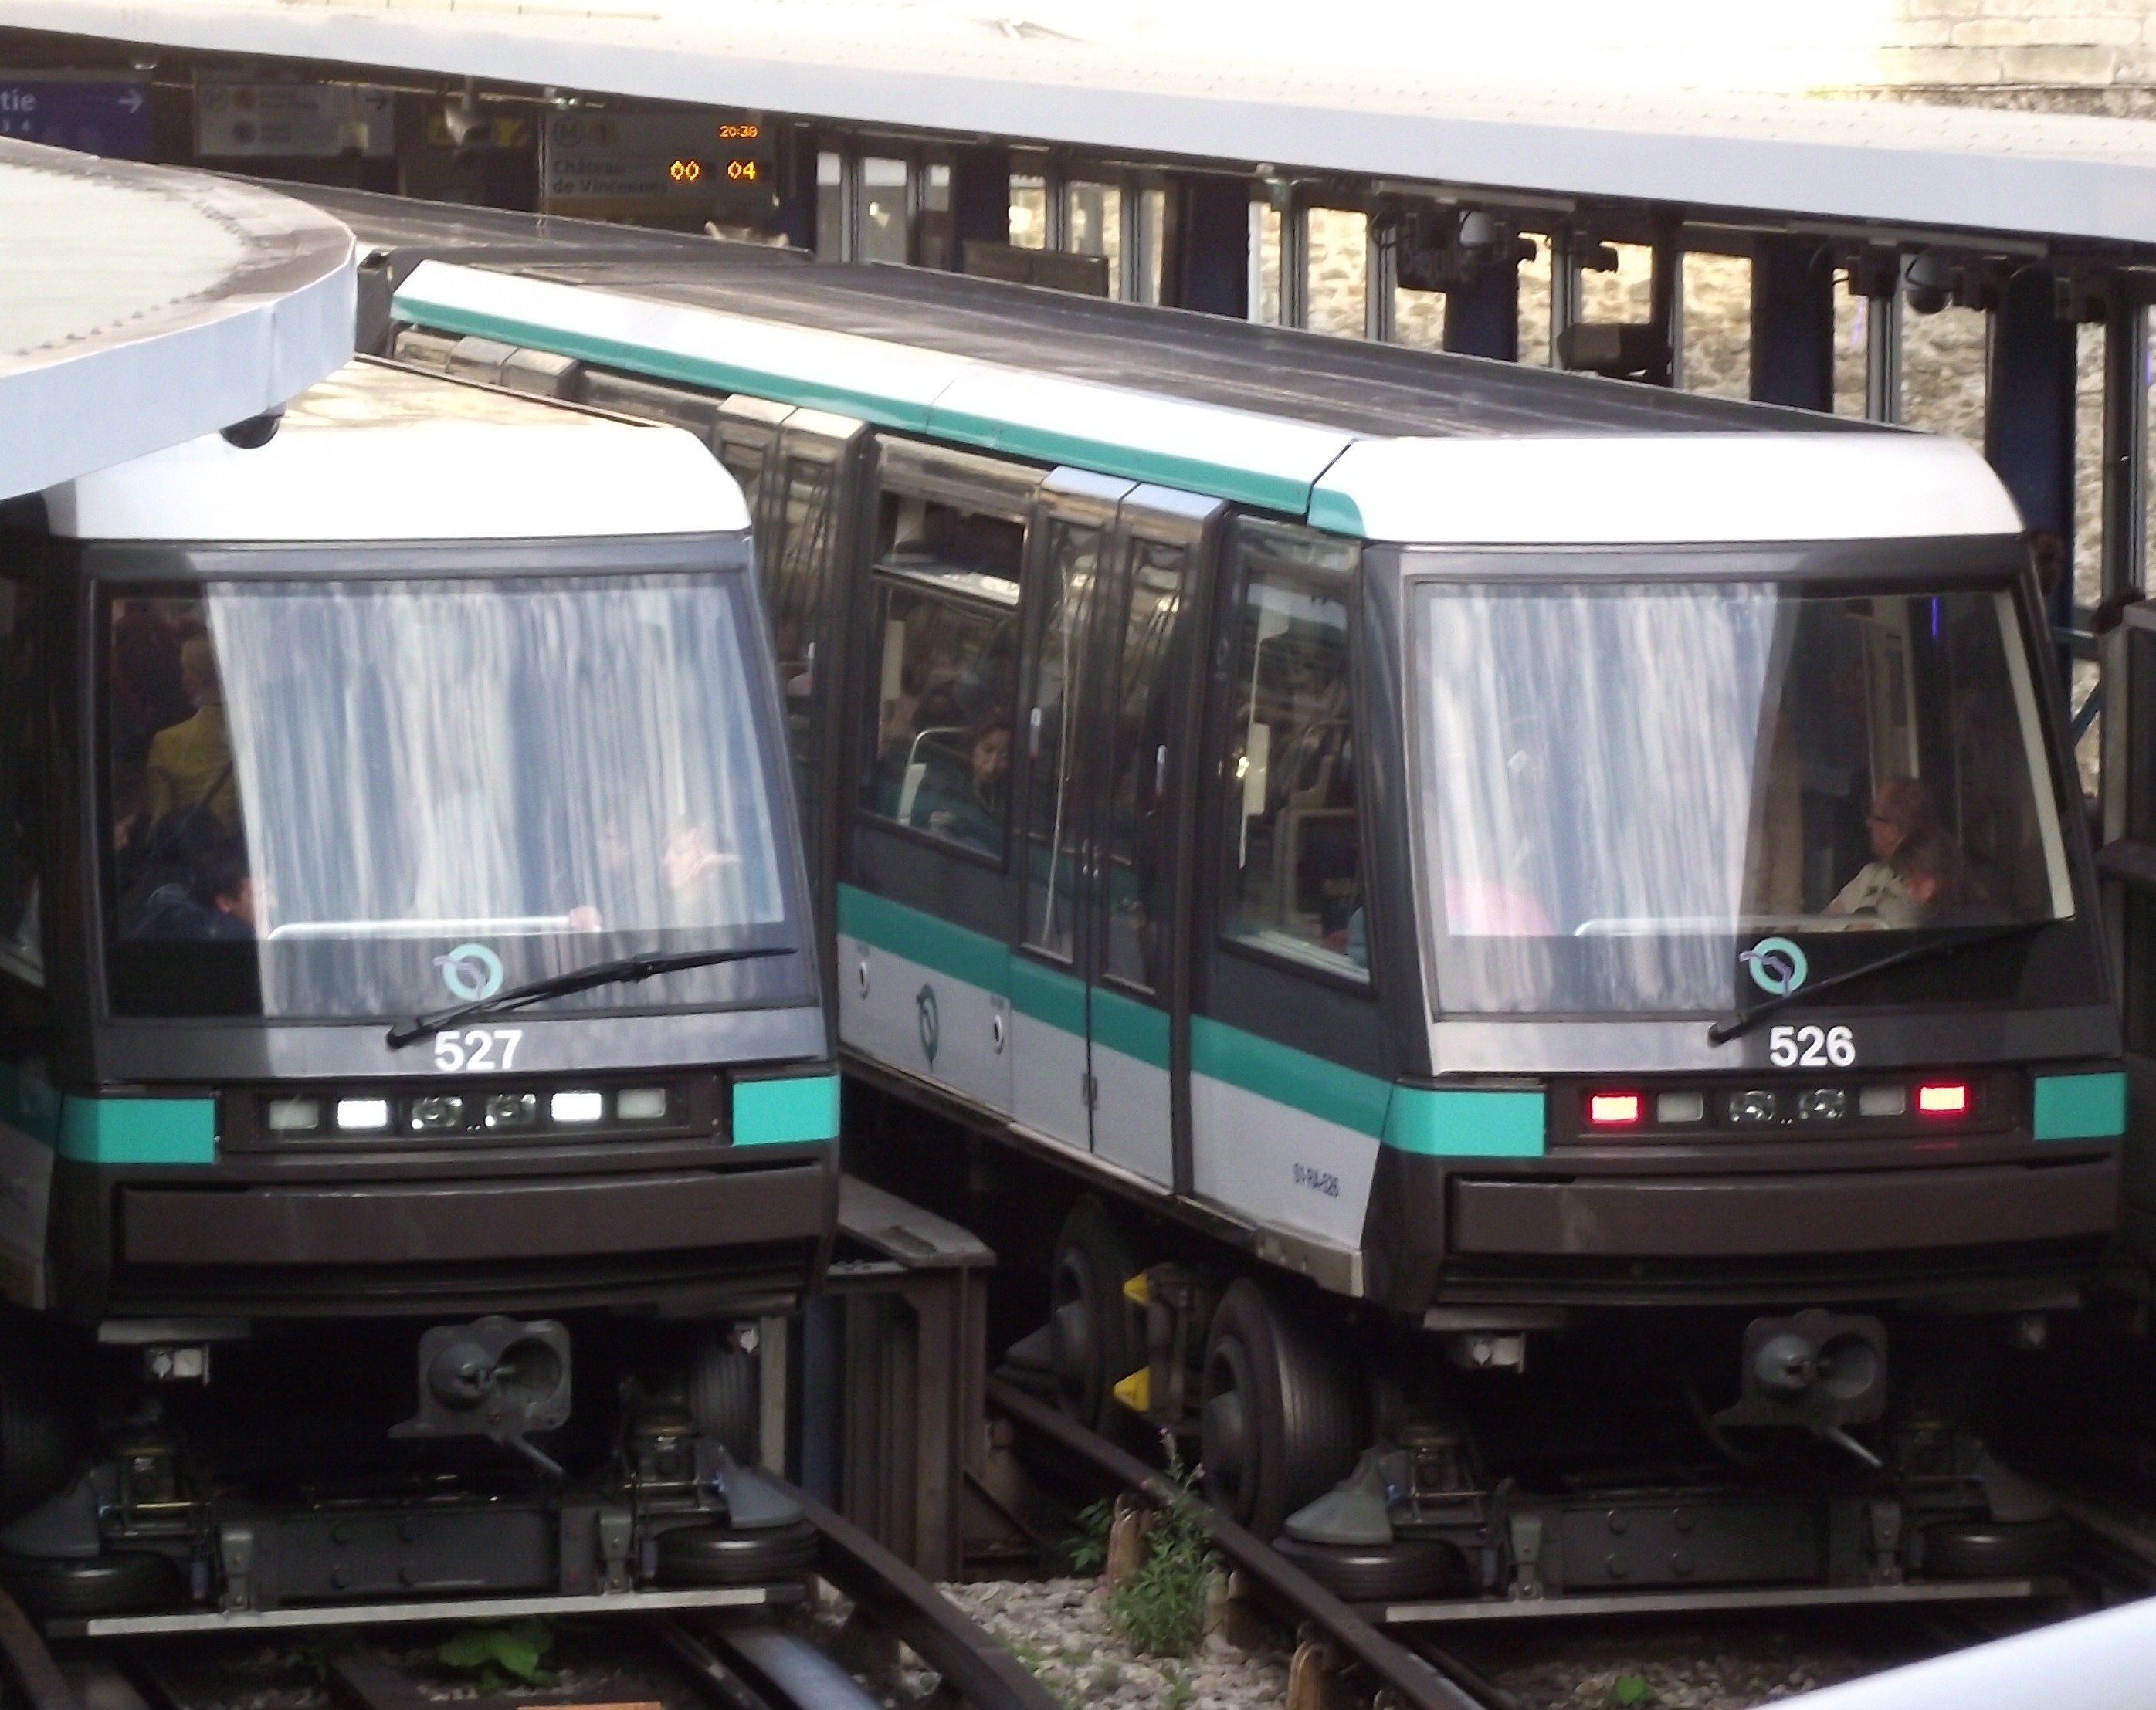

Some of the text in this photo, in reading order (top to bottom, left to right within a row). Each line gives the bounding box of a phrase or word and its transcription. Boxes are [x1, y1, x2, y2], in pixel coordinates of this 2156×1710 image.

[670, 160, 756, 180] 00 04
[434, 1029, 523, 1072] 527
[1769, 1025, 1856, 1068] 526
